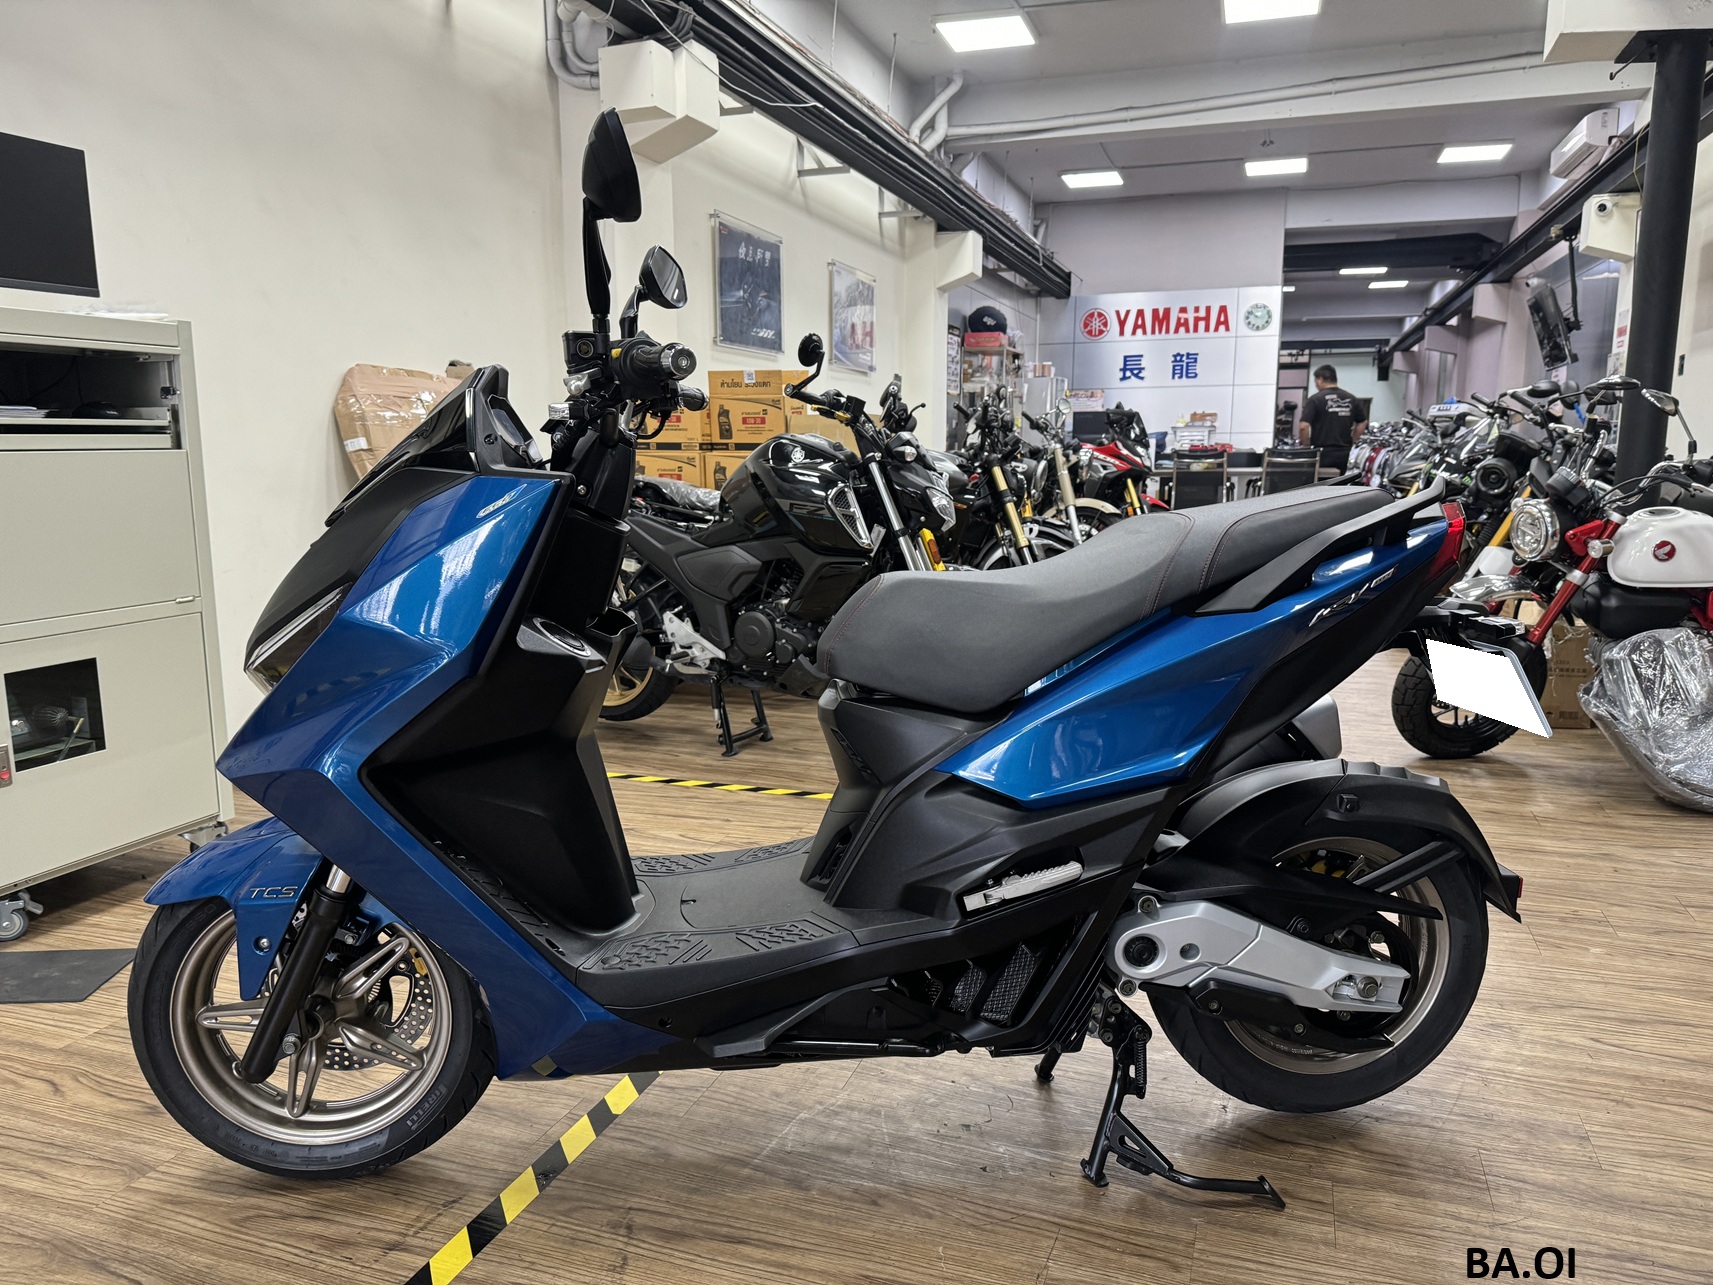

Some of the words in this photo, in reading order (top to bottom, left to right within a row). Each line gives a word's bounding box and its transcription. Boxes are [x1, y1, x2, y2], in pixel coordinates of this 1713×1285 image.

[1114, 304, 1231, 337] YAMAHA
[1118, 352, 1199, 382] 長龍
[249, 885, 299, 900] TCS
